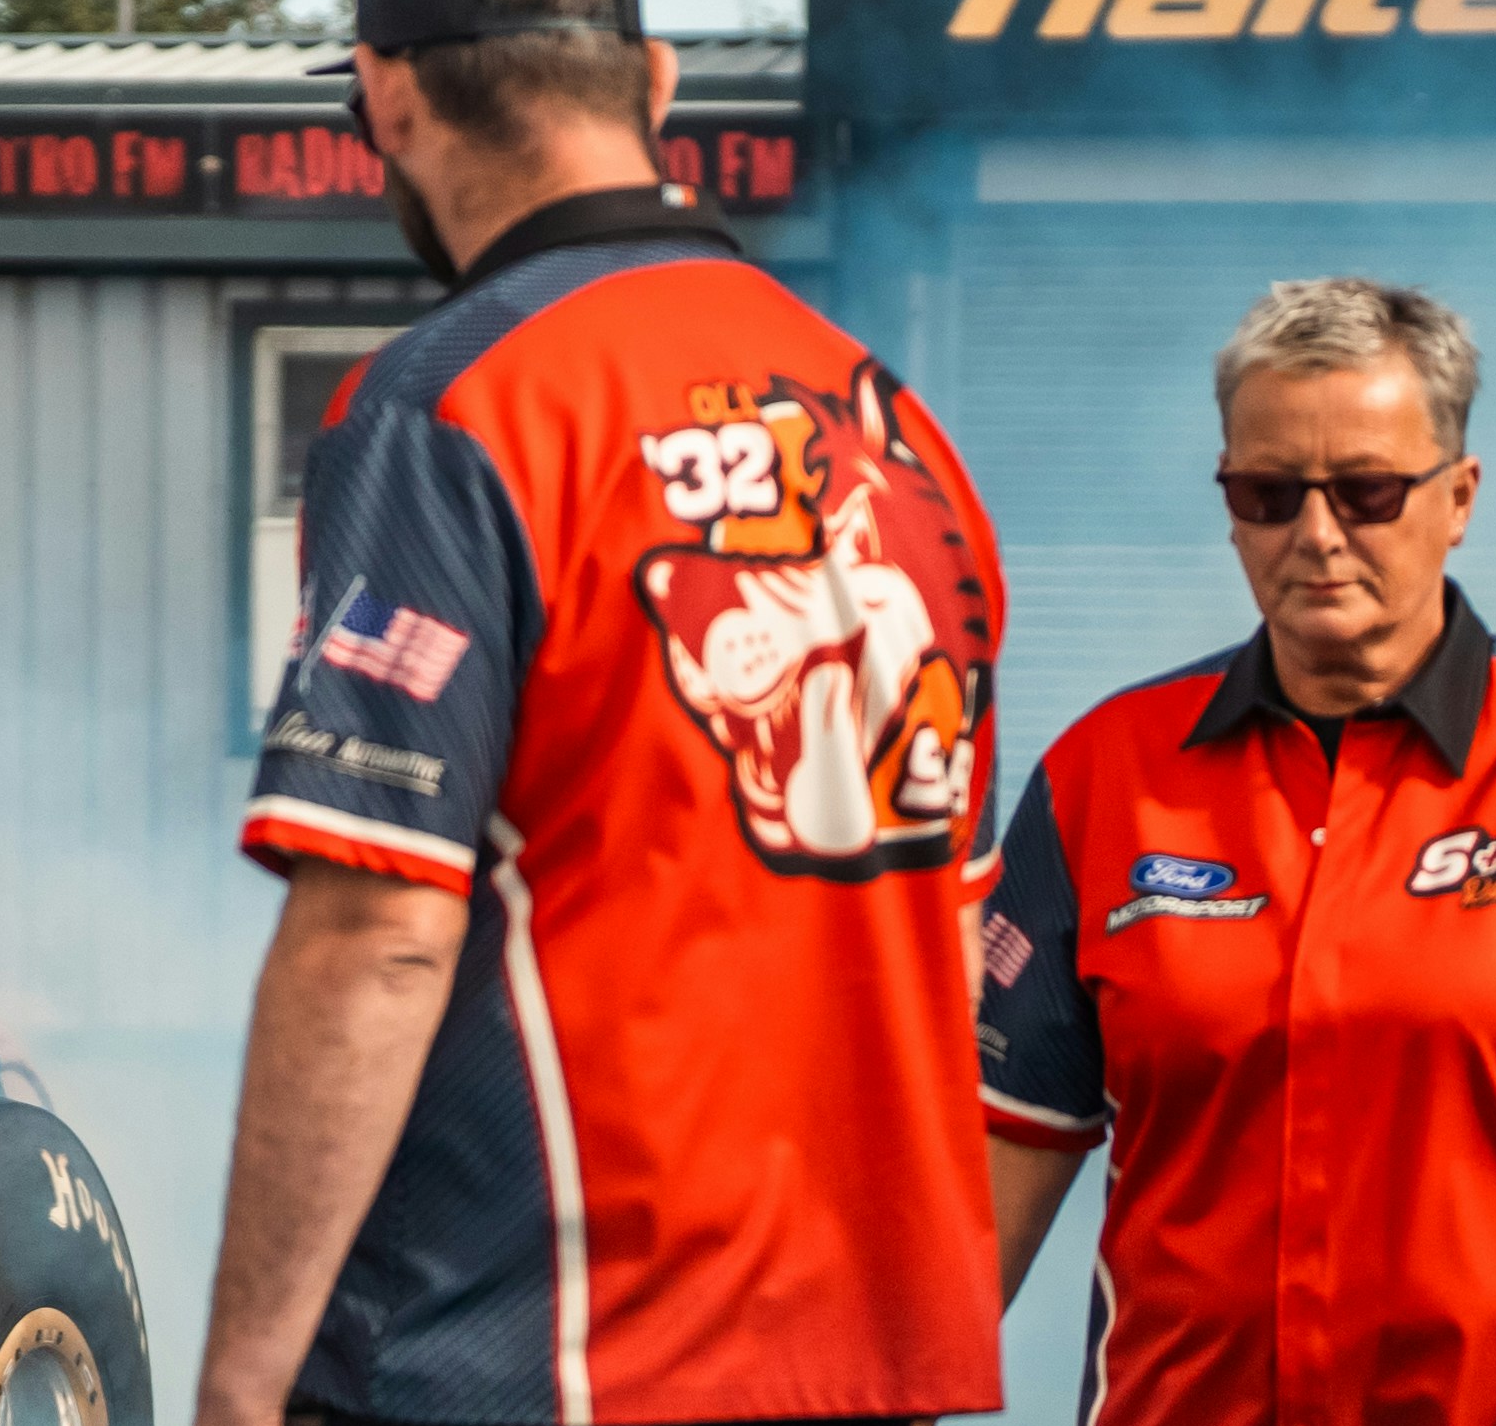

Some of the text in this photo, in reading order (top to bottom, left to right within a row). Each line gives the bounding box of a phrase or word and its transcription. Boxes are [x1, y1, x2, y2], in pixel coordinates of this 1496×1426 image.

[112, 130, 186, 196] FM
[718, 130, 796, 199] FM
[1143, 857, 1213, 891] Ford
